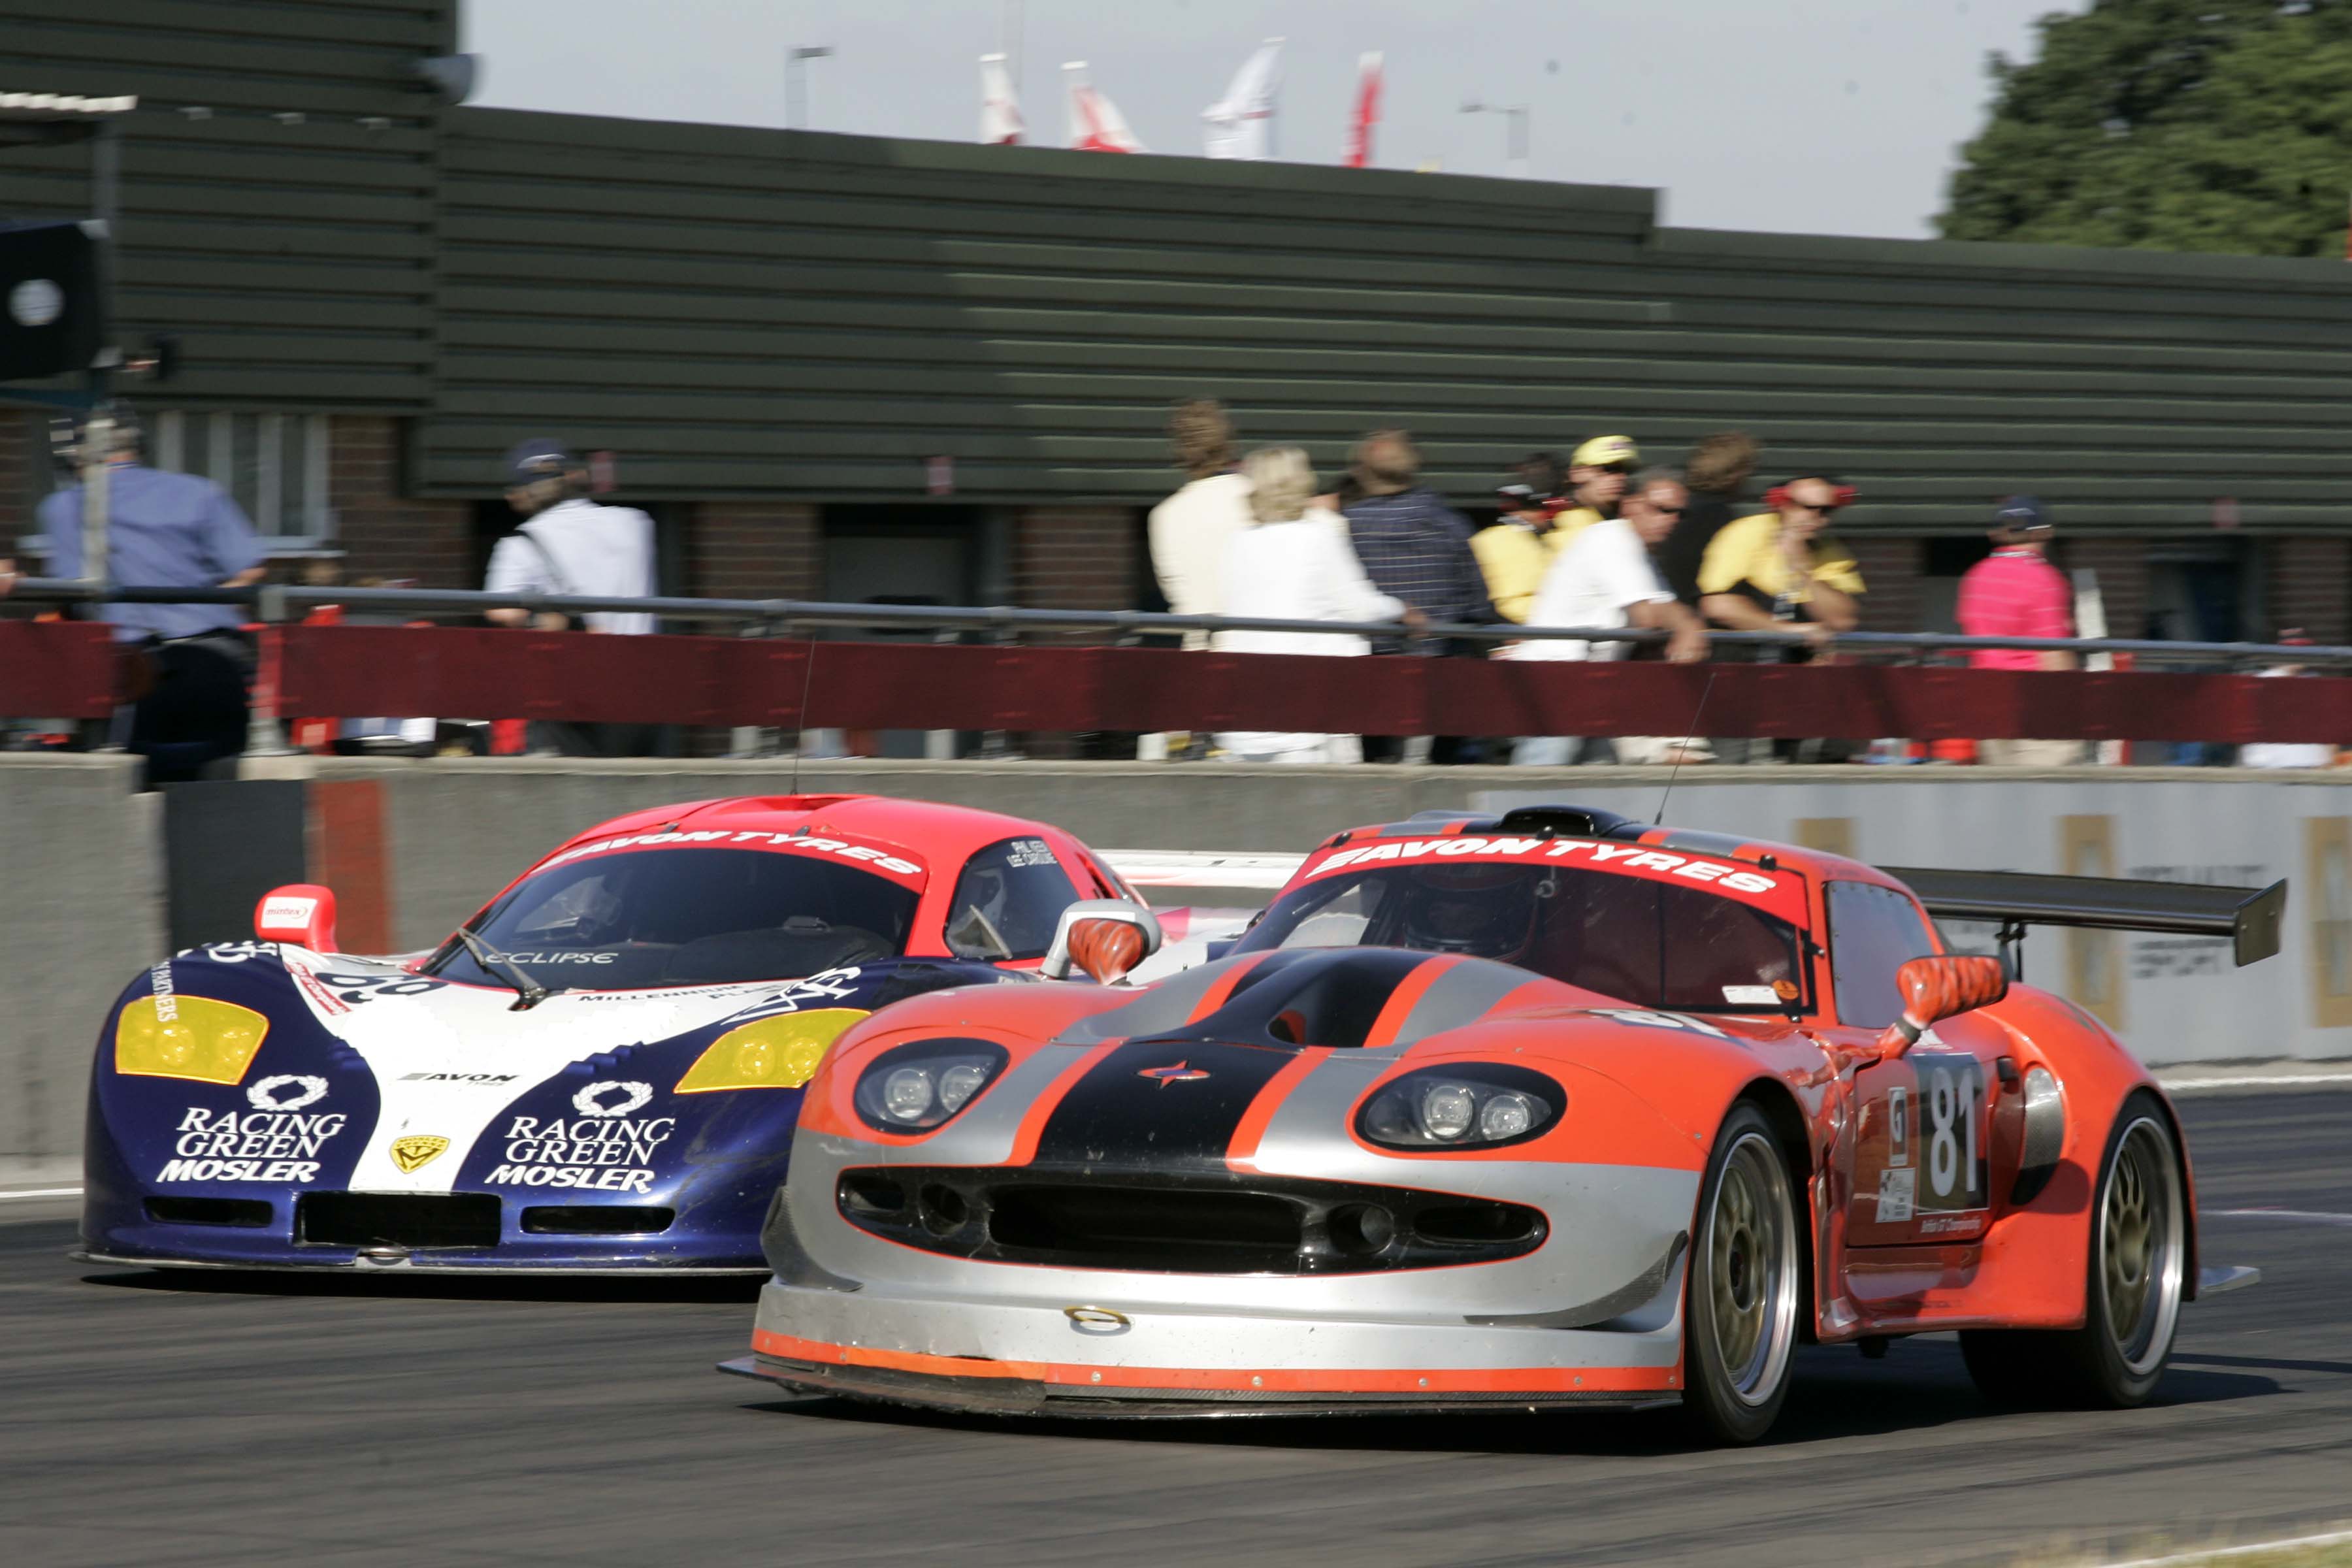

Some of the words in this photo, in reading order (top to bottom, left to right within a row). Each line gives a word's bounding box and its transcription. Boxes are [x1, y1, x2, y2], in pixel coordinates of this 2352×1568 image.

[585, 830, 733, 854] AVON
[729, 831, 922, 875] TYRES
[1356, 838, 1543, 863] AVON
[1548, 840, 1777, 893] TYRES
[485, 952, 619, 964] ECLIPSE
[176, 1107, 348, 1137] RACING
[504, 1116, 676, 1142] RACING
[1930, 1066, 1978, 1197] 81
[176, 1132, 327, 1158] GREEN
[506, 1139, 659, 1166] GREEN
[155, 1159, 321, 1183] MOSLER
[484, 1164, 655, 1194] MOSLER
